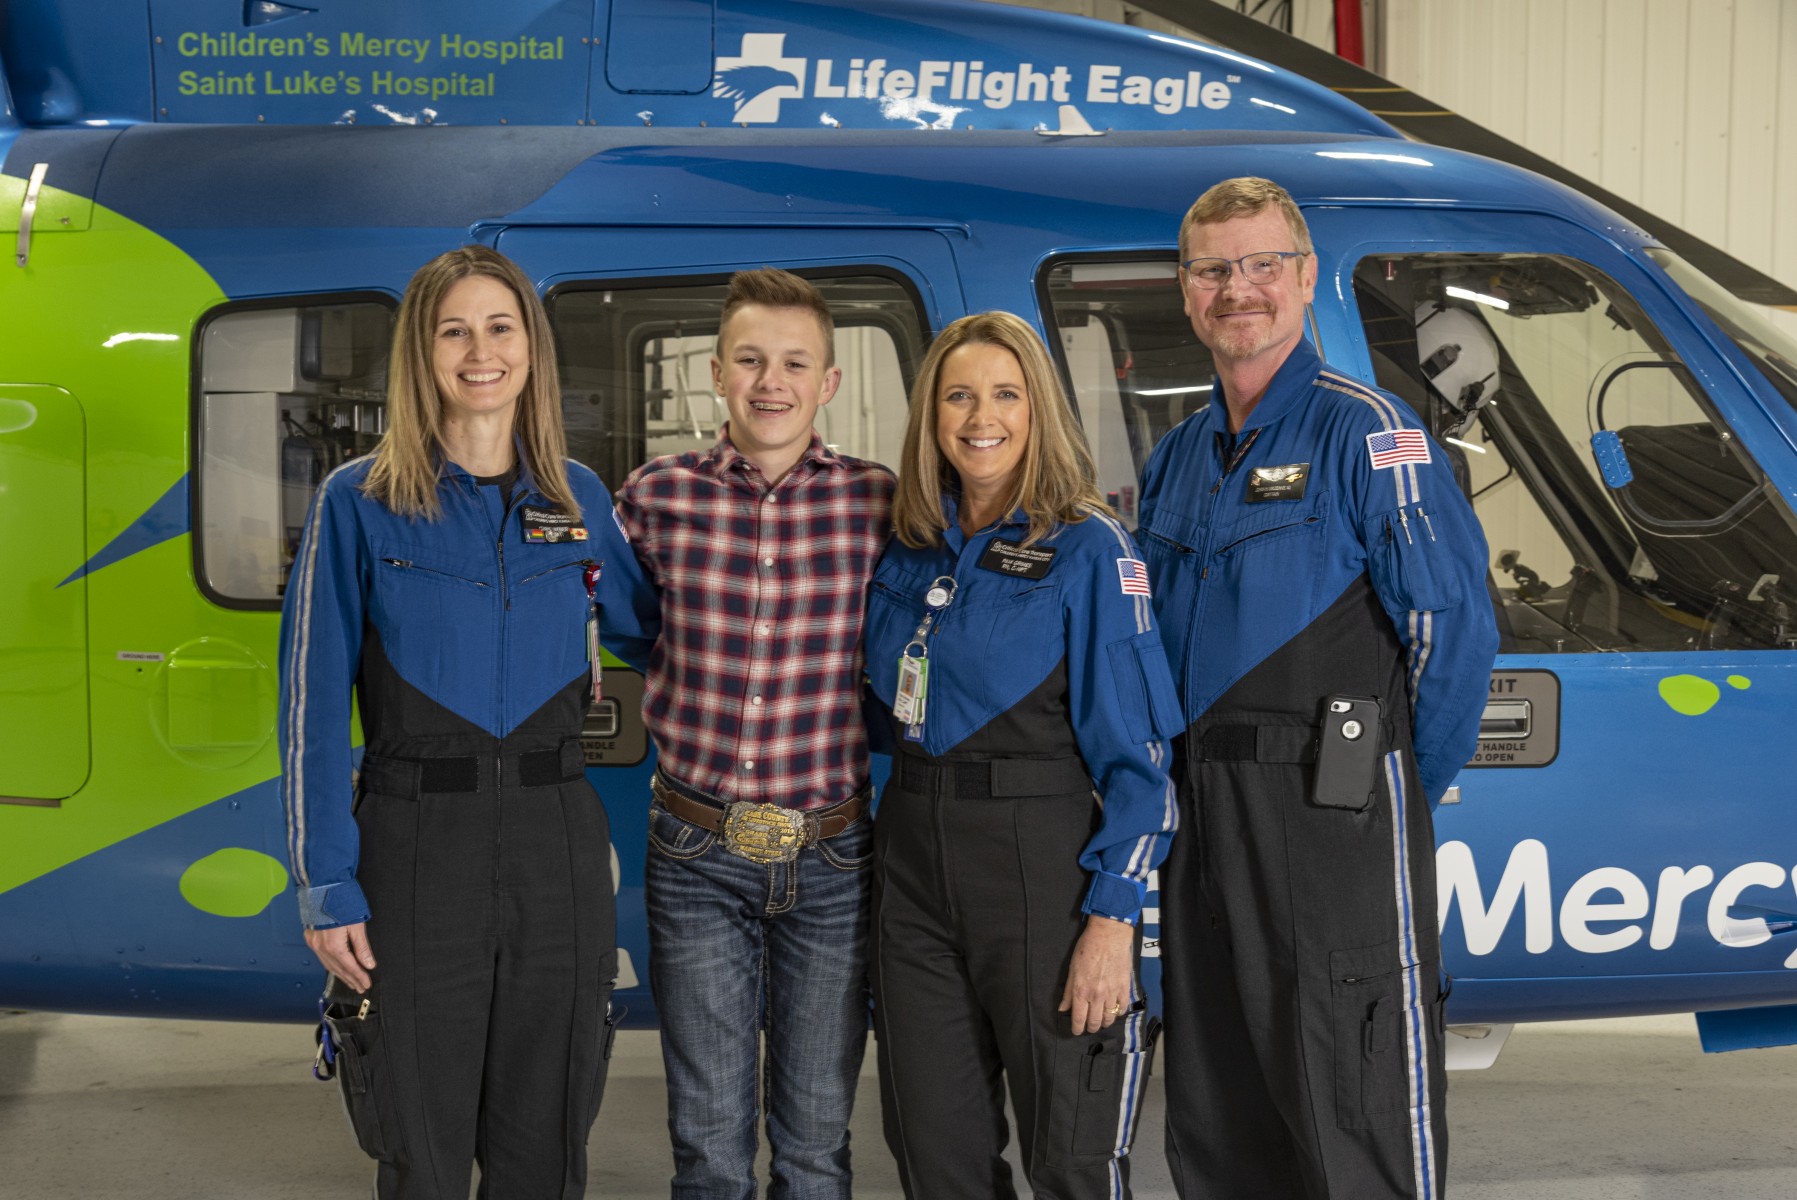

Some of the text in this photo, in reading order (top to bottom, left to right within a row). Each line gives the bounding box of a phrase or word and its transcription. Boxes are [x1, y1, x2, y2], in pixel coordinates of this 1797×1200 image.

[178, 32, 564, 65] Children’s Mercy Hospital
[178, 70, 495, 101] Saint Luke’s Hospital
[814, 59, 1072, 108] LifeFlight
[1086, 65, 1231, 114] Eagle
[579, 741, 616, 750] ANDLE
[584, 751, 603, 760] PEN
[1483, 743, 1526, 751] HANDLE
[1485, 753, 1514, 761] OPEN
[1436, 838, 1797, 969] Merc
